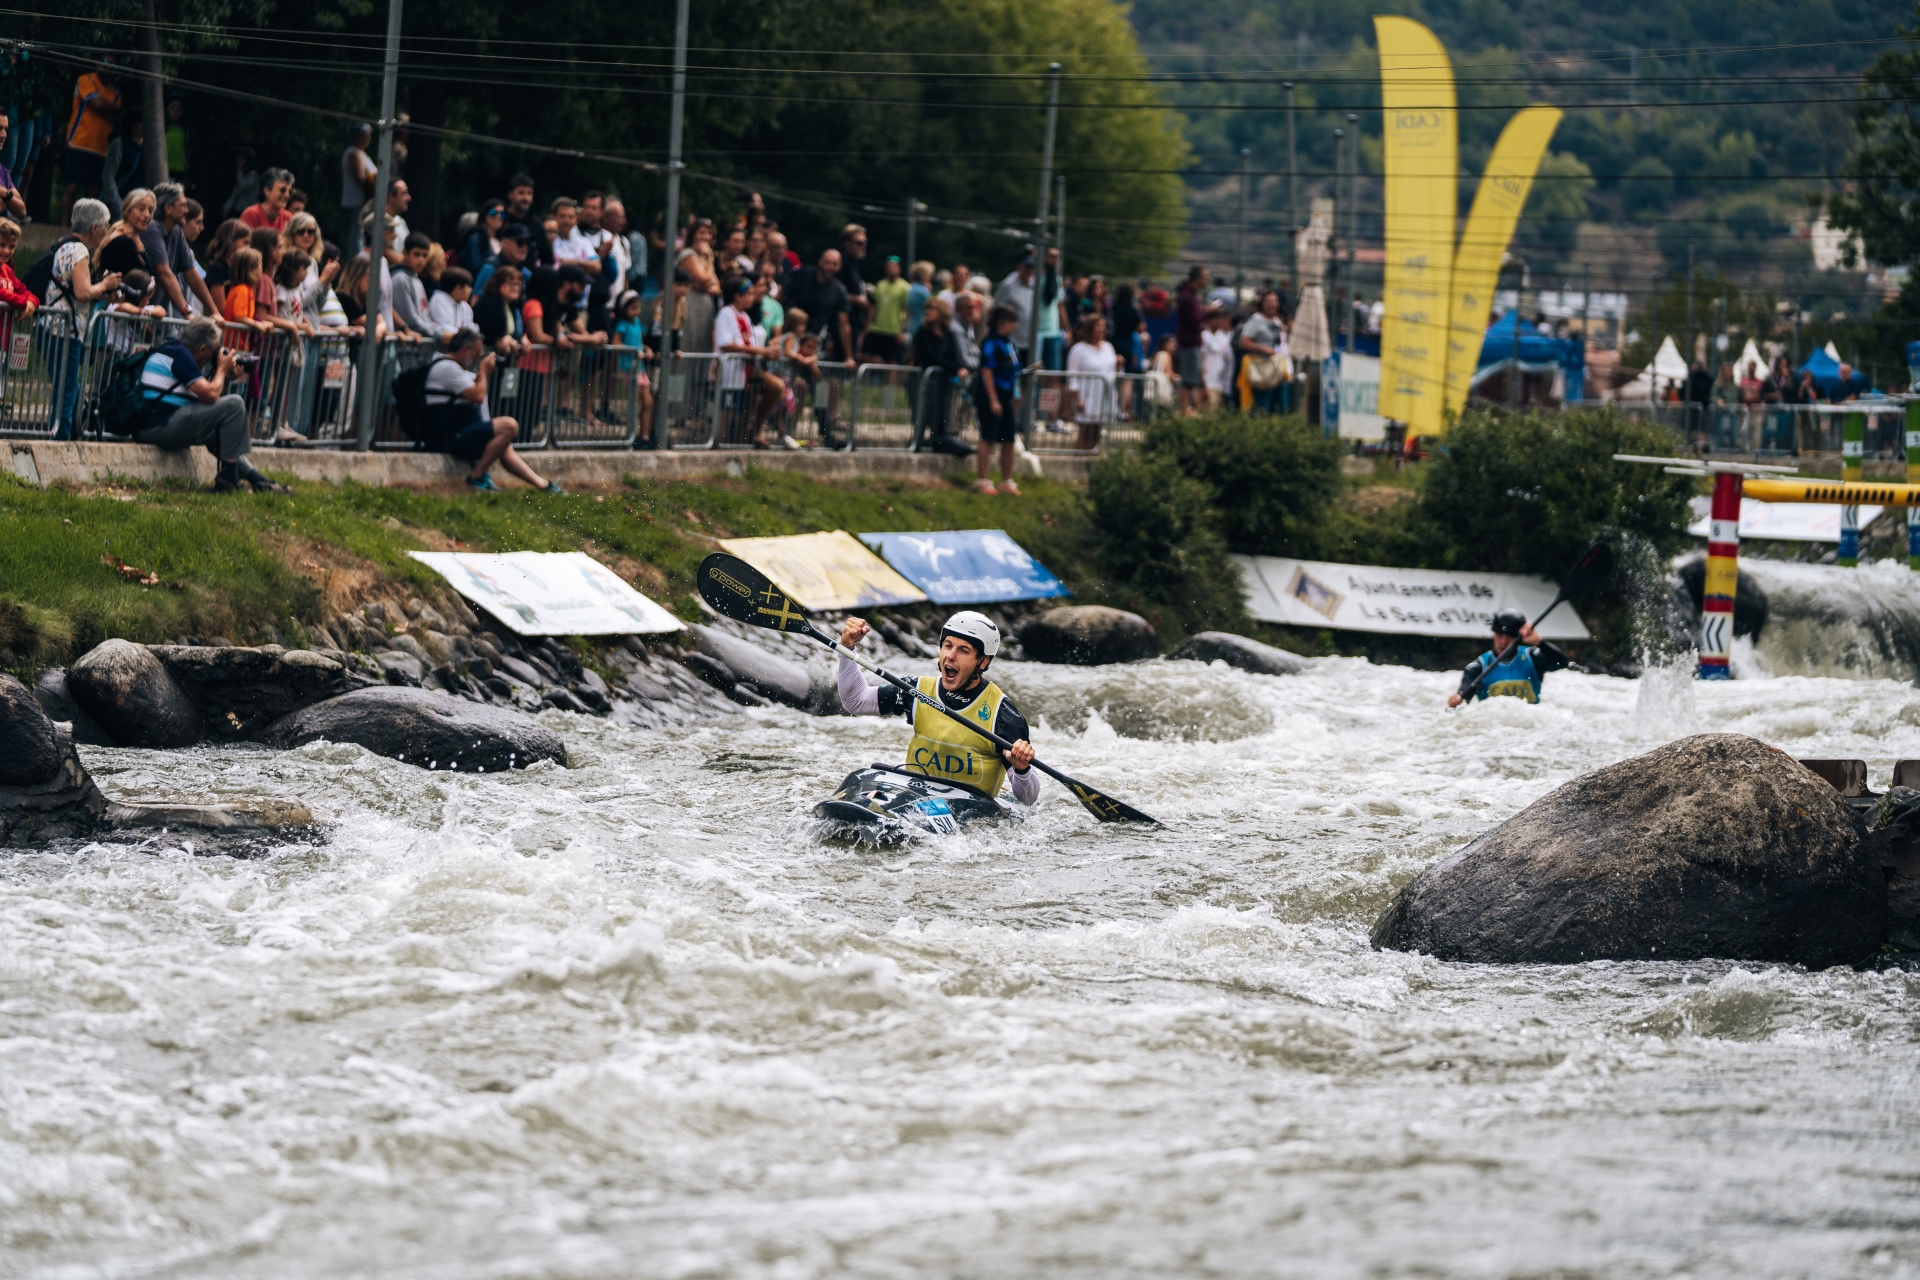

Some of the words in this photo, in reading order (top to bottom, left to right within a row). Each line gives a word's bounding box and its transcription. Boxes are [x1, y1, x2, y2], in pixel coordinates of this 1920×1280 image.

[1347, 574, 1465, 597] Ajuntament
[1469, 581, 1494, 598] de
[1358, 602, 1388, 620] La
[1389, 605, 1433, 624] Seu
[1437, 607, 1498, 626] d'Urg
[914, 747, 974, 776] CADÍ
